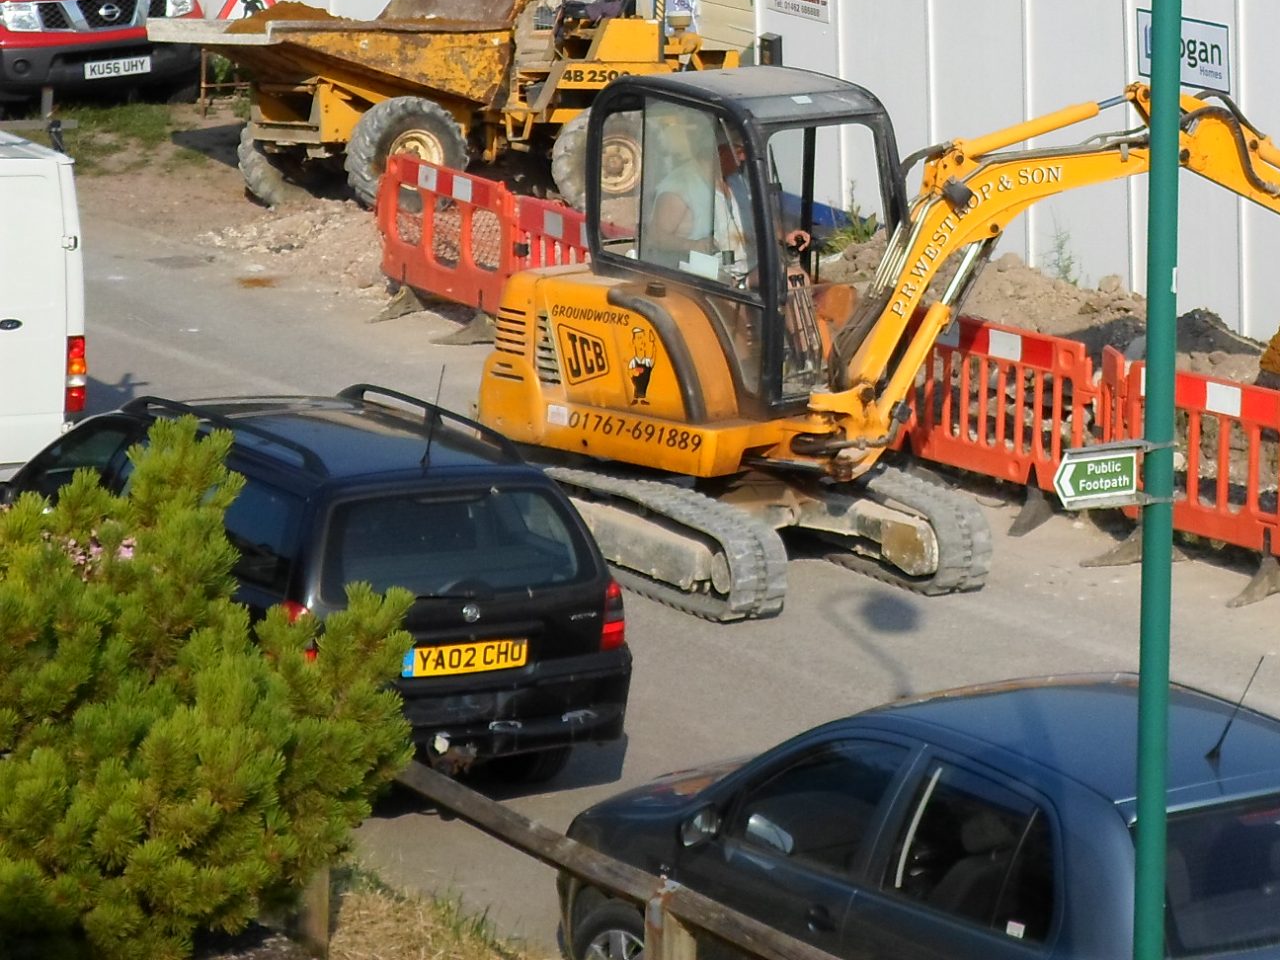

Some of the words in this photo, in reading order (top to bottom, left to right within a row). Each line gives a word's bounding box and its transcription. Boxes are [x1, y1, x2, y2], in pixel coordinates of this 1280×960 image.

[1180, 38, 1222, 68] gan
[89, 62, 120, 76] KU56
[123, 59, 145, 72] UHY
[1200, 66, 1223, 80] Homes
[997, 174, 1013, 193] &
[1018, 166, 1062, 185] SON
[551, 304, 630, 327] GROUNDWORKS
[566, 331, 606, 378] JCB
[568, 411, 703, 453] 01767-691889
[1087, 460, 1122, 475] Public
[1079, 475, 1130, 492] Footpath
[419, 646, 477, 671] YA02
